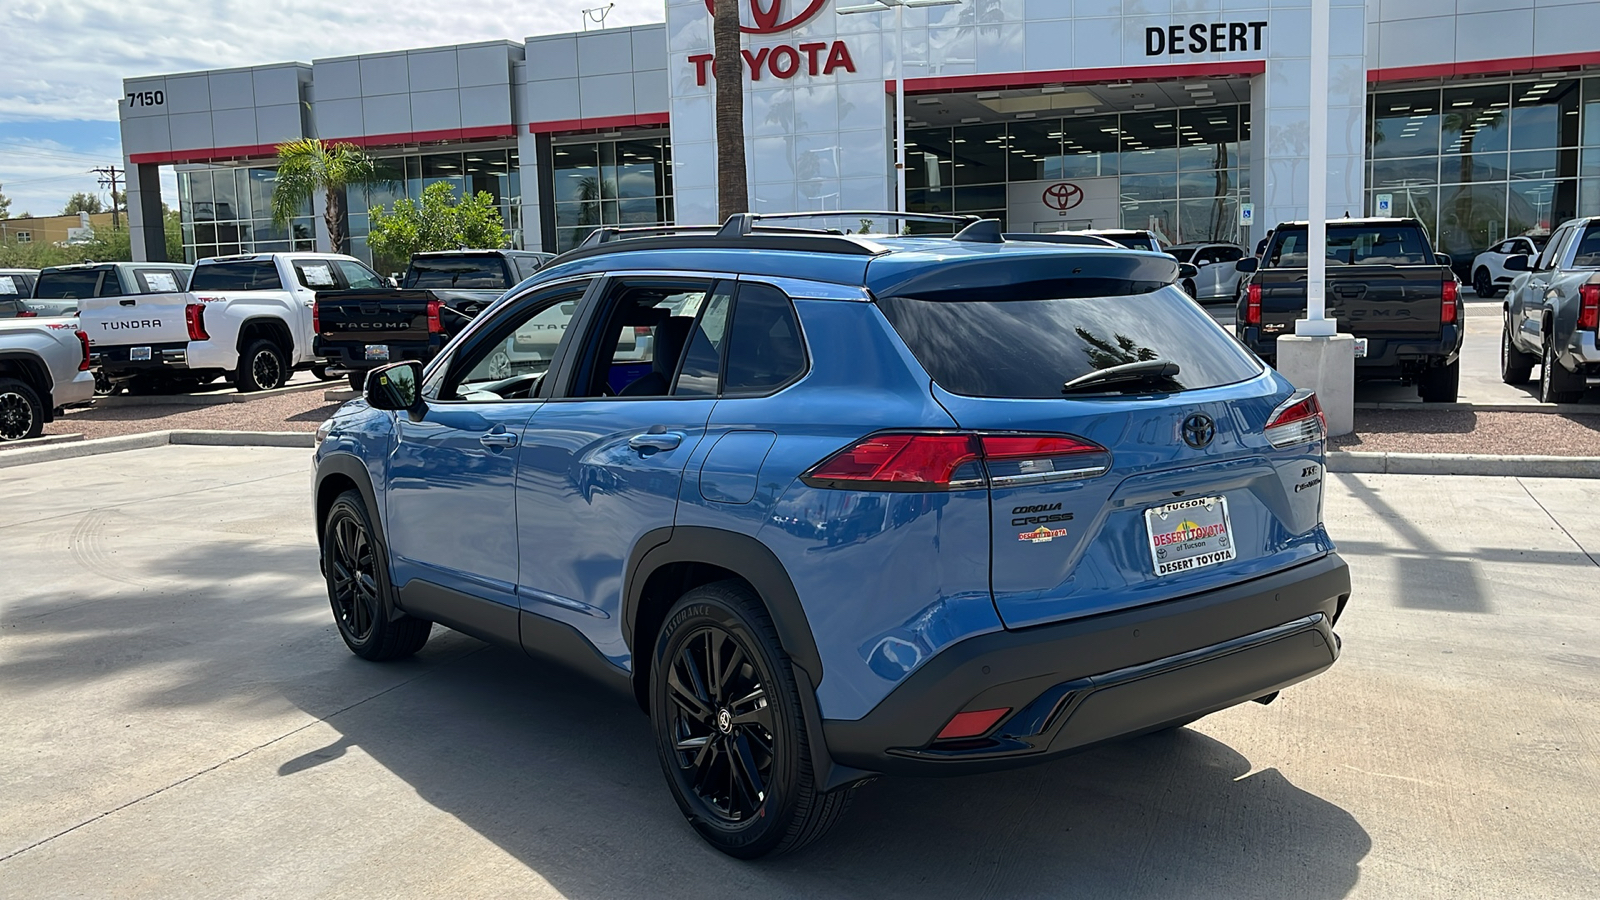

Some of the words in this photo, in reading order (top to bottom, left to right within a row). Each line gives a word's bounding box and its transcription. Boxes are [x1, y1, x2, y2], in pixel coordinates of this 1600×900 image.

[1145, 21, 1268, 56] DESERT
[688, 40, 856, 86] TYOTA
[127, 90, 164, 107] 7150
[101, 319, 162, 331] TUNDRA
[1012, 502, 1062, 514] COROLLA
[1166, 499, 1206, 511] TUCSON
[1012, 512, 1074, 526] CROSS
[1018, 532, 1041, 540] DESERT
[1043, 529, 1067, 538] TOYOTA
[1153, 530, 1187, 547] DESERT
[1189, 523, 1225, 540] TOYOTA
[1176, 544, 1183, 552] of
[1184, 541, 1206, 550] Tucson
[1160, 559, 1193, 573] DESERT
[1196, 550, 1232, 565] TOYOTA
[665, 605, 710, 639] ASSURANCE
